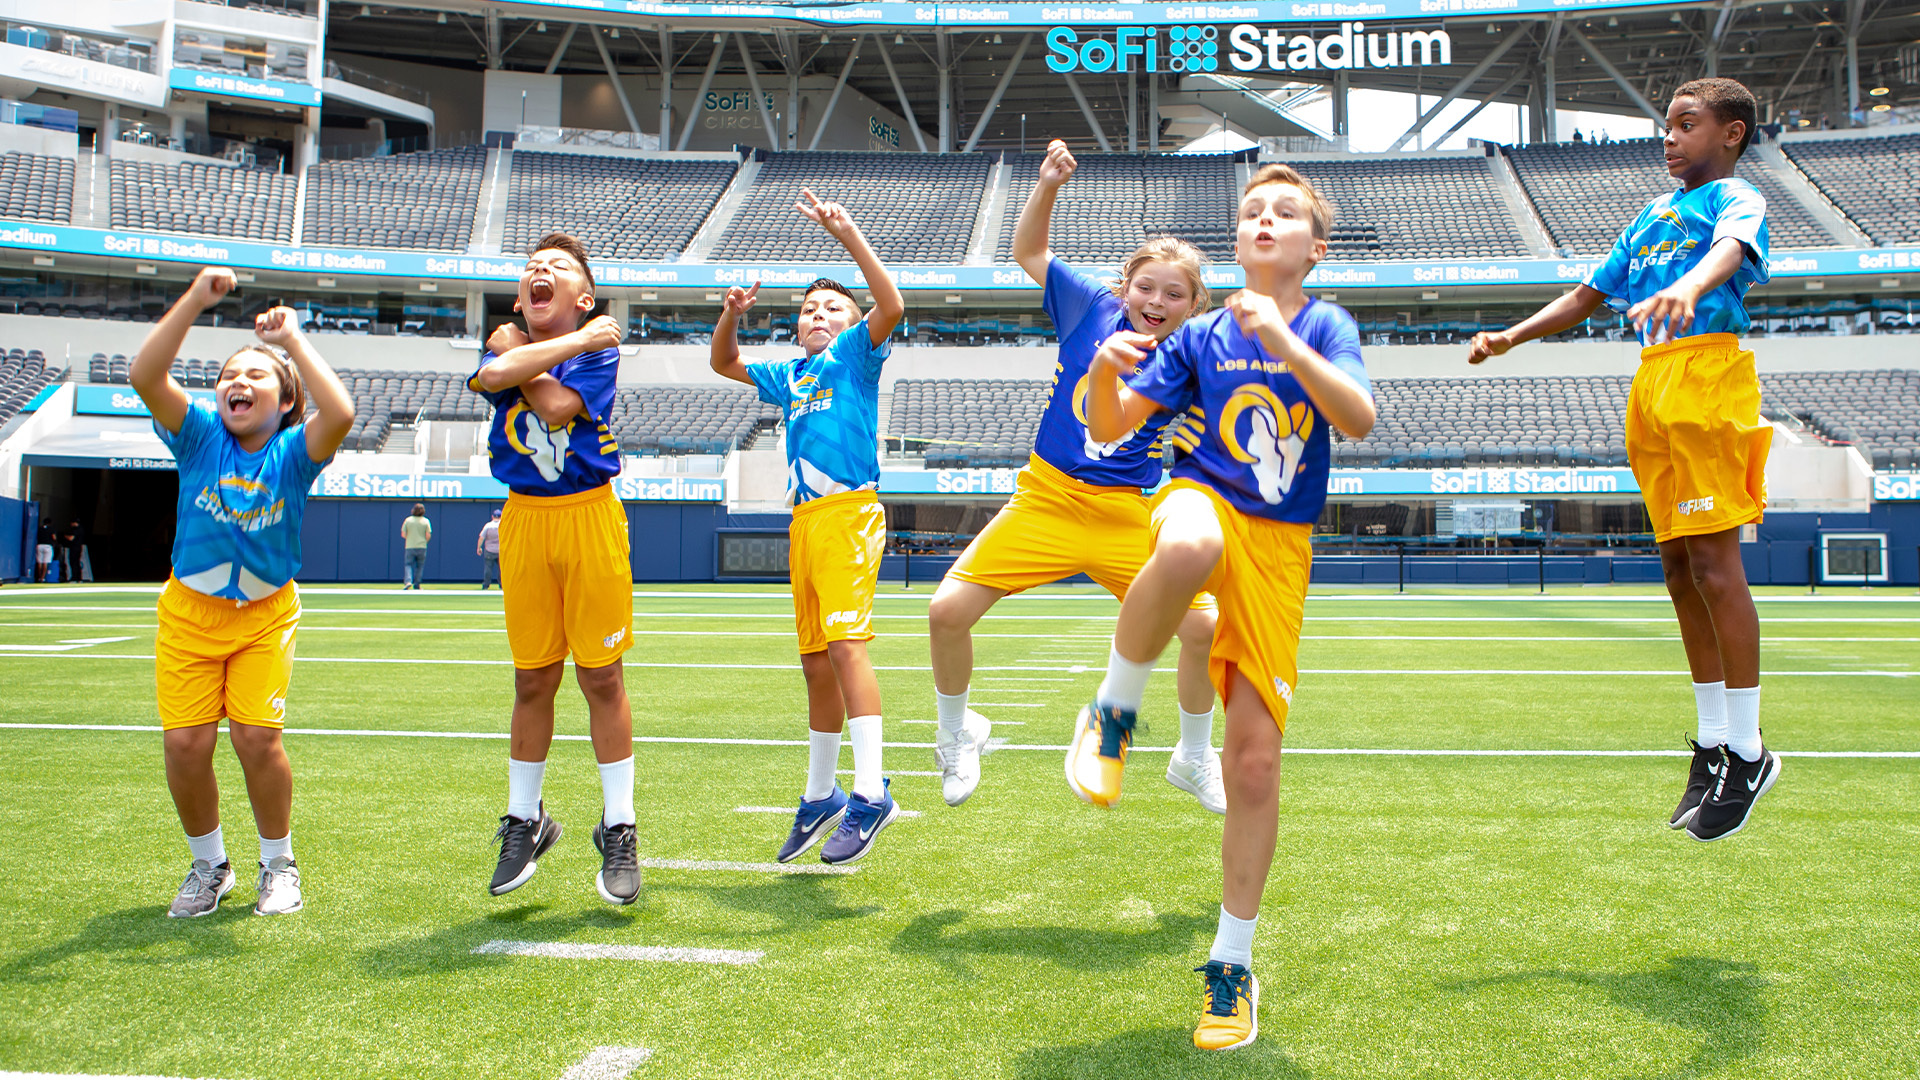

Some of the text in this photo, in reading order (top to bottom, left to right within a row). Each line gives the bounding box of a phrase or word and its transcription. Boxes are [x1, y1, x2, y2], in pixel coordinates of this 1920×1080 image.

[796, 7, 882, 19] SoFi Stadium
[915, 8, 1009, 20] SoFi Stadium
[1042, 8, 1133, 20] SoFi Stadium
[1166, 6, 1258, 19] SoFi Stadium
[1291, 3, 1386, 16] SoFi Stadium
[1045, 22, 1451, 74] SoFi Stadium
[196, 75, 284, 97] SoFi Stadium
[705, 92, 749, 111] SoFi
[705, 116, 762, 129] CIRCL
[0, 228, 56, 245] adium
[104, 235, 229, 260] SoFi Stadium
[271, 250, 386, 270] SoFi Stadium
[425, 258, 524, 276] SoFi Stadiu
[1858, 253, 1893, 268] SoFi
[621, 267, 677, 281] Stadium
[715, 268, 817, 283] SoFi Stadium
[900, 270, 956, 284] Stadium
[992, 271, 1022, 284] SoFi
[1319, 269, 1376, 282] Stadium
[1413, 266, 1518, 281] SoFi Stadium
[1557, 263, 1589, 278] SoFi
[1216, 359, 1248, 372] LOS
[109, 458, 131, 468] SoFi
[353, 473, 462, 498] Stadium
[620, 477, 722, 500] Stadium
[936, 471, 987, 493] SoFi
[1430, 471, 1617, 493] SoFi Stadium
[1875, 476, 1920, 499] SoF
